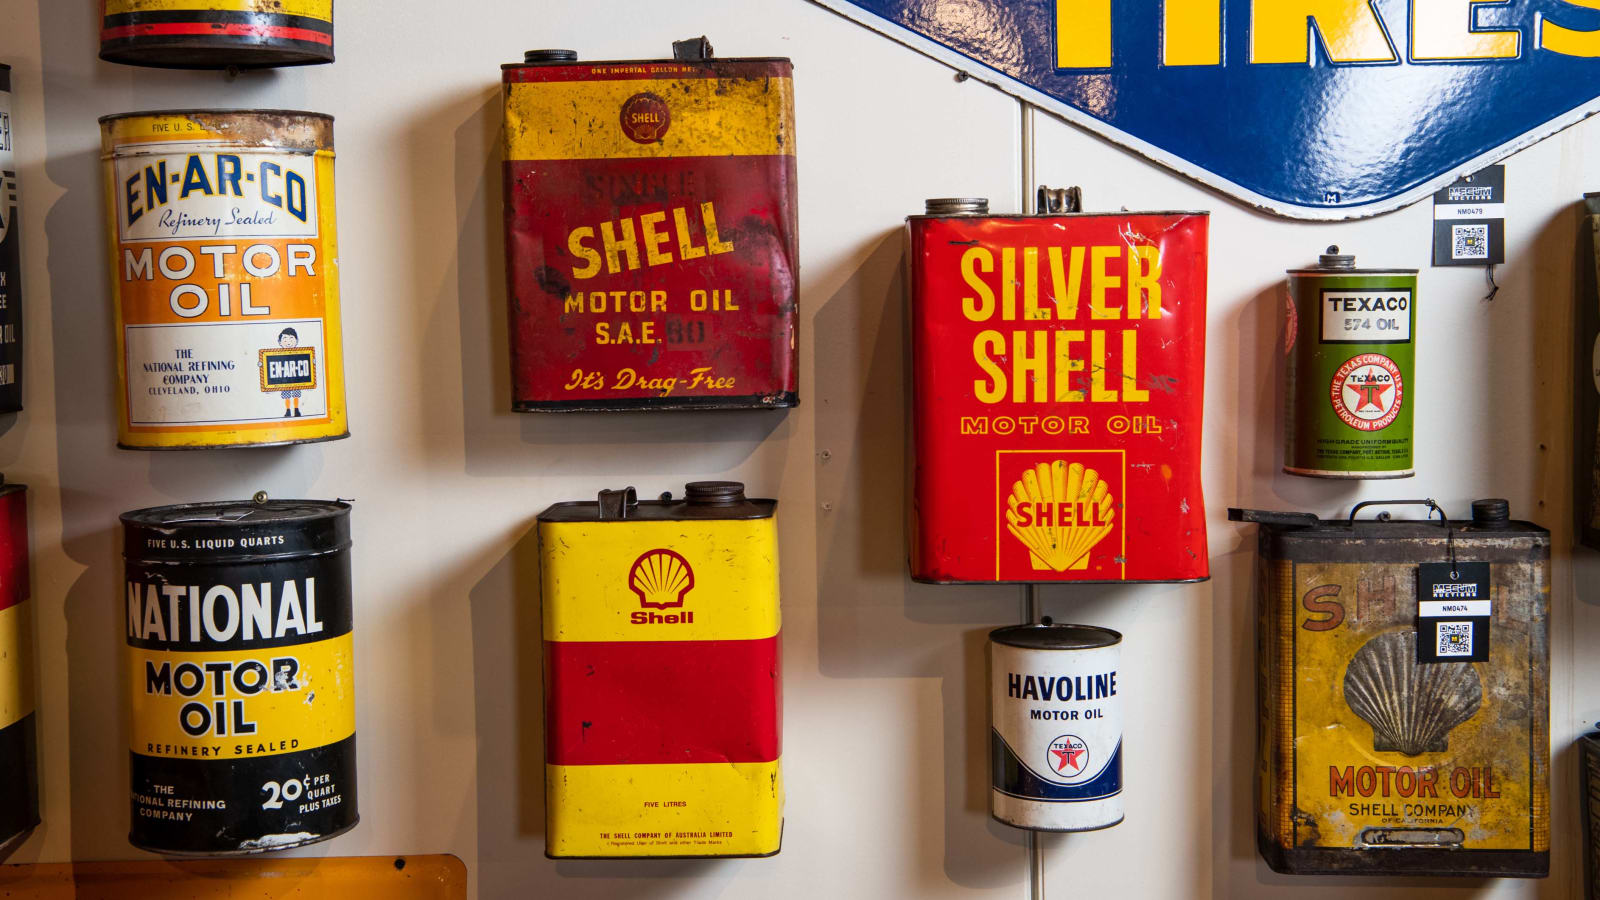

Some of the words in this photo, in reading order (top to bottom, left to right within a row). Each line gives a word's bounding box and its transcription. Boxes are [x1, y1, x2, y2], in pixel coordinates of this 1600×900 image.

[632, 112, 659, 123] SHELL
[152, 123, 169, 133] FIVE
[158, 209, 221, 235] Refinery
[225, 207, 276, 226] Sealed
[567, 201, 734, 279] SHELL
[124, 243, 317, 281] MOTOR
[960, 245, 1162, 322] SILVER
[169, 282, 271, 318] OIL
[564, 290, 668, 313] MOTOR
[690, 289, 740, 311] OIL
[1328, 297, 1407, 312] TEXACO
[595, 321, 662, 345] S.A.E.
[1344, 318, 1371, 331] 574
[1376, 318, 1399, 331] OIL
[175, 349, 193, 359] THE
[143, 362, 183, 373] NATIONAL
[188, 360, 235, 372] REFINING
[973, 329, 1150, 404] SHELL
[1331, 380, 1341, 396] THE
[1338, 357, 1362, 378] TEXAS
[1362, 355, 1399, 373] COMPANY
[163, 374, 210, 385] COMPANY
[564, 368, 604, 391] It's
[611, 366, 736, 397] Drag-Free
[1350, 374, 1390, 383] TEXACO
[148, 386, 200, 396] CLEVELAND,
[204, 386, 230, 394] OHIO
[1360, 385, 1379, 403] T
[1335, 398, 1371, 429] PETROLEUM
[1372, 399, 1402, 429] PRODUCTS
[961, 415, 1090, 435] MOTOR
[1107, 415, 1162, 434] OIL
[1016, 501, 1106, 528] SHELL
[147, 539, 166, 549] FIVE
[171, 539, 190, 549] U.S.
[195, 539, 235, 549] LIQUID
[240, 535, 285, 547] QUARTS
[128, 577, 323, 643] NATIONAL
[630, 611, 694, 624] Shell
[145, 656, 302, 698] MOTOR
[1008, 671, 1117, 702] HAVOLINE
[179, 699, 257, 738] OIL
[1030, 709, 1079, 721] MOTOR
[1084, 708, 1103, 719] OIL
[147, 743, 221, 756] REFINERY
[234, 739, 299, 754] SEALED
[314, 774, 330, 786] PER
[1329, 765, 1439, 799] MOTOR
[1450, 766, 1501, 799] OIL
[153, 784, 175, 795] THE
[307, 784, 335, 800] QUART
[167, 798, 226, 810] REFINING
[299, 801, 320, 814] PLUS
[321, 794, 342, 808] TAXES
[1349, 803, 1399, 816] SHELL
[1404, 803, 1476, 818] COMPANY
[140, 807, 193, 822] COMPANY
